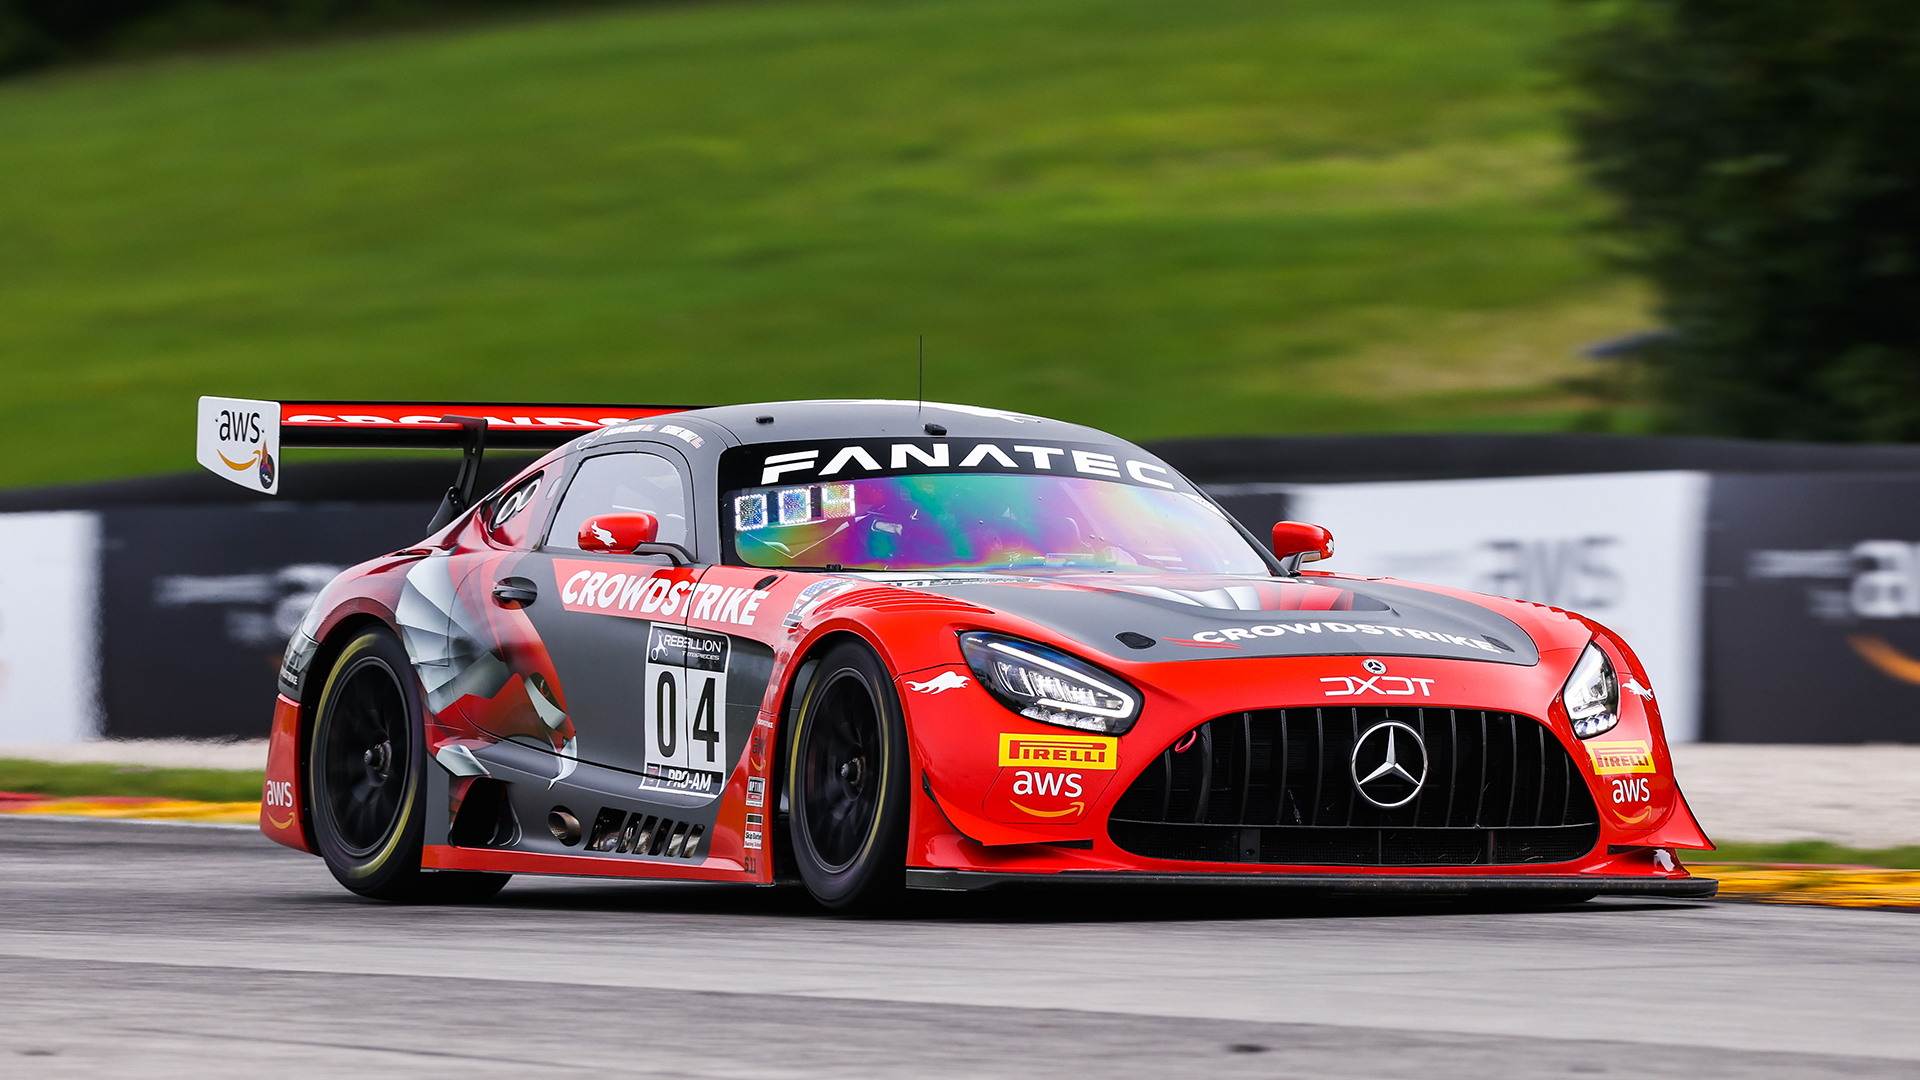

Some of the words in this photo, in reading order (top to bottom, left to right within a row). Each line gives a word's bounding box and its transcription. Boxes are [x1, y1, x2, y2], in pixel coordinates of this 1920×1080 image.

[219, 409, 260, 444] aws
[761, 443, 1174, 490] FANATEC
[734, 484, 855, 531] 004
[561, 569, 771, 626] CROWDSTRIKE
[664, 633, 722, 653] REBELLION
[1192, 622, 1502, 654] CROWDSTRIKE
[681, 651, 720, 661] TMEPIECES
[1320, 676, 1435, 697] DXDT
[656, 670, 720, 763] 04
[1009, 740, 1108, 763] PIRELLI
[1592, 747, 1649, 768] PIRELLI
[266, 780, 293, 807] aws
[666, 769, 712, 792] PRO-AM
[1012, 770, 1083, 798] aws
[1612, 778, 1650, 803] aws
